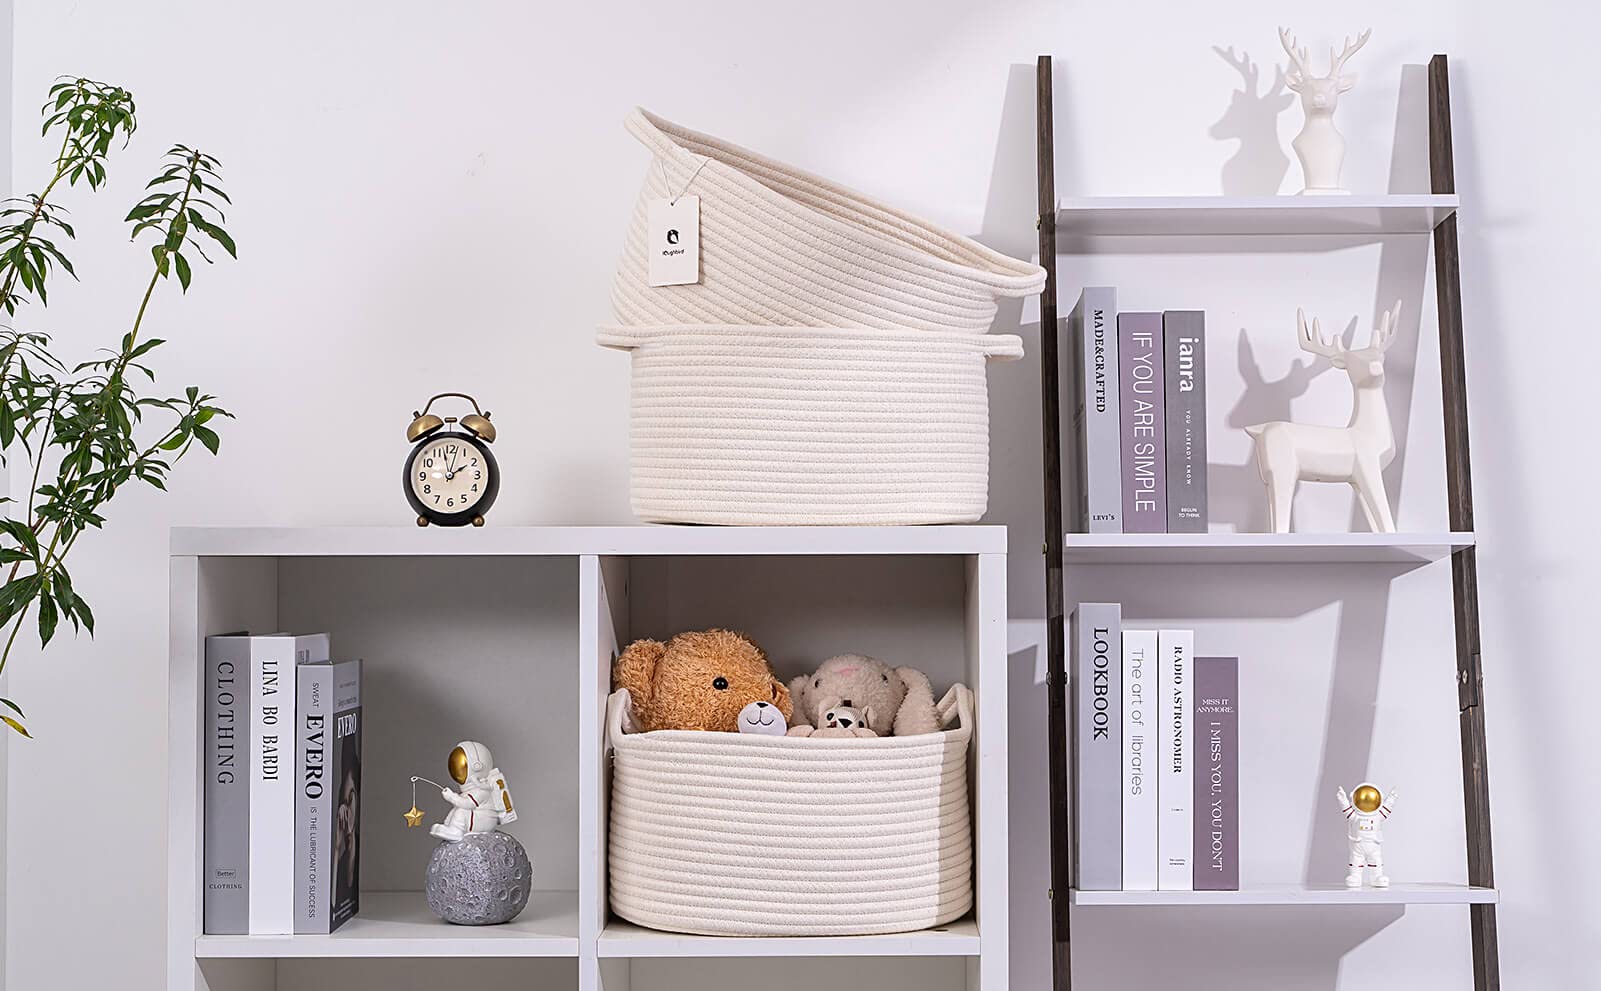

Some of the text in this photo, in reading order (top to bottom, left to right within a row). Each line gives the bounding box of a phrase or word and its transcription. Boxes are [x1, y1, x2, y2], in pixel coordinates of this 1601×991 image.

[1093, 309, 1106, 413] MADE&CRAFTED
[1179, 337, 1200, 393] ianra
[1132, 332, 1156, 512] IF YOU ARE SIMPLE
[433, 448, 441, 458] 11
[446, 444, 457, 454] 12
[471, 457, 478, 467] 2
[419, 471, 427, 481] 9
[423, 458, 433, 468] 10
[474, 470, 481, 480] 3
[423, 484, 431, 494] 8
[434, 494, 441, 504] 7
[460, 494, 468, 504] 5
[471, 483, 478, 493] 4
[446, 497, 454, 507] 6
[1092, 513, 1115, 521] LEVI'S
[312, 682, 320, 707] SWEAT
[1093, 627, 1109, 741] LOOKBOOK
[217, 661, 235, 785] CLOTHING
[262, 660, 279, 781] LINA BO BARDI
[1131, 648, 1145, 796] The art of libraries
[1173, 646, 1183, 774] RADIO ASTRONOMER
[337, 712, 357, 739] EVERO
[305, 713, 325, 800] EVERO
[1210, 729, 1222, 762] MISS
[310, 806, 318, 814] IS
[1211, 799, 1222, 828] YOU
[309, 832, 317, 872] LUBRICANT
[1212, 831, 1223, 871] DON'T
[309, 873, 316, 884] OF
[308, 885, 316, 919] SUCCESS
